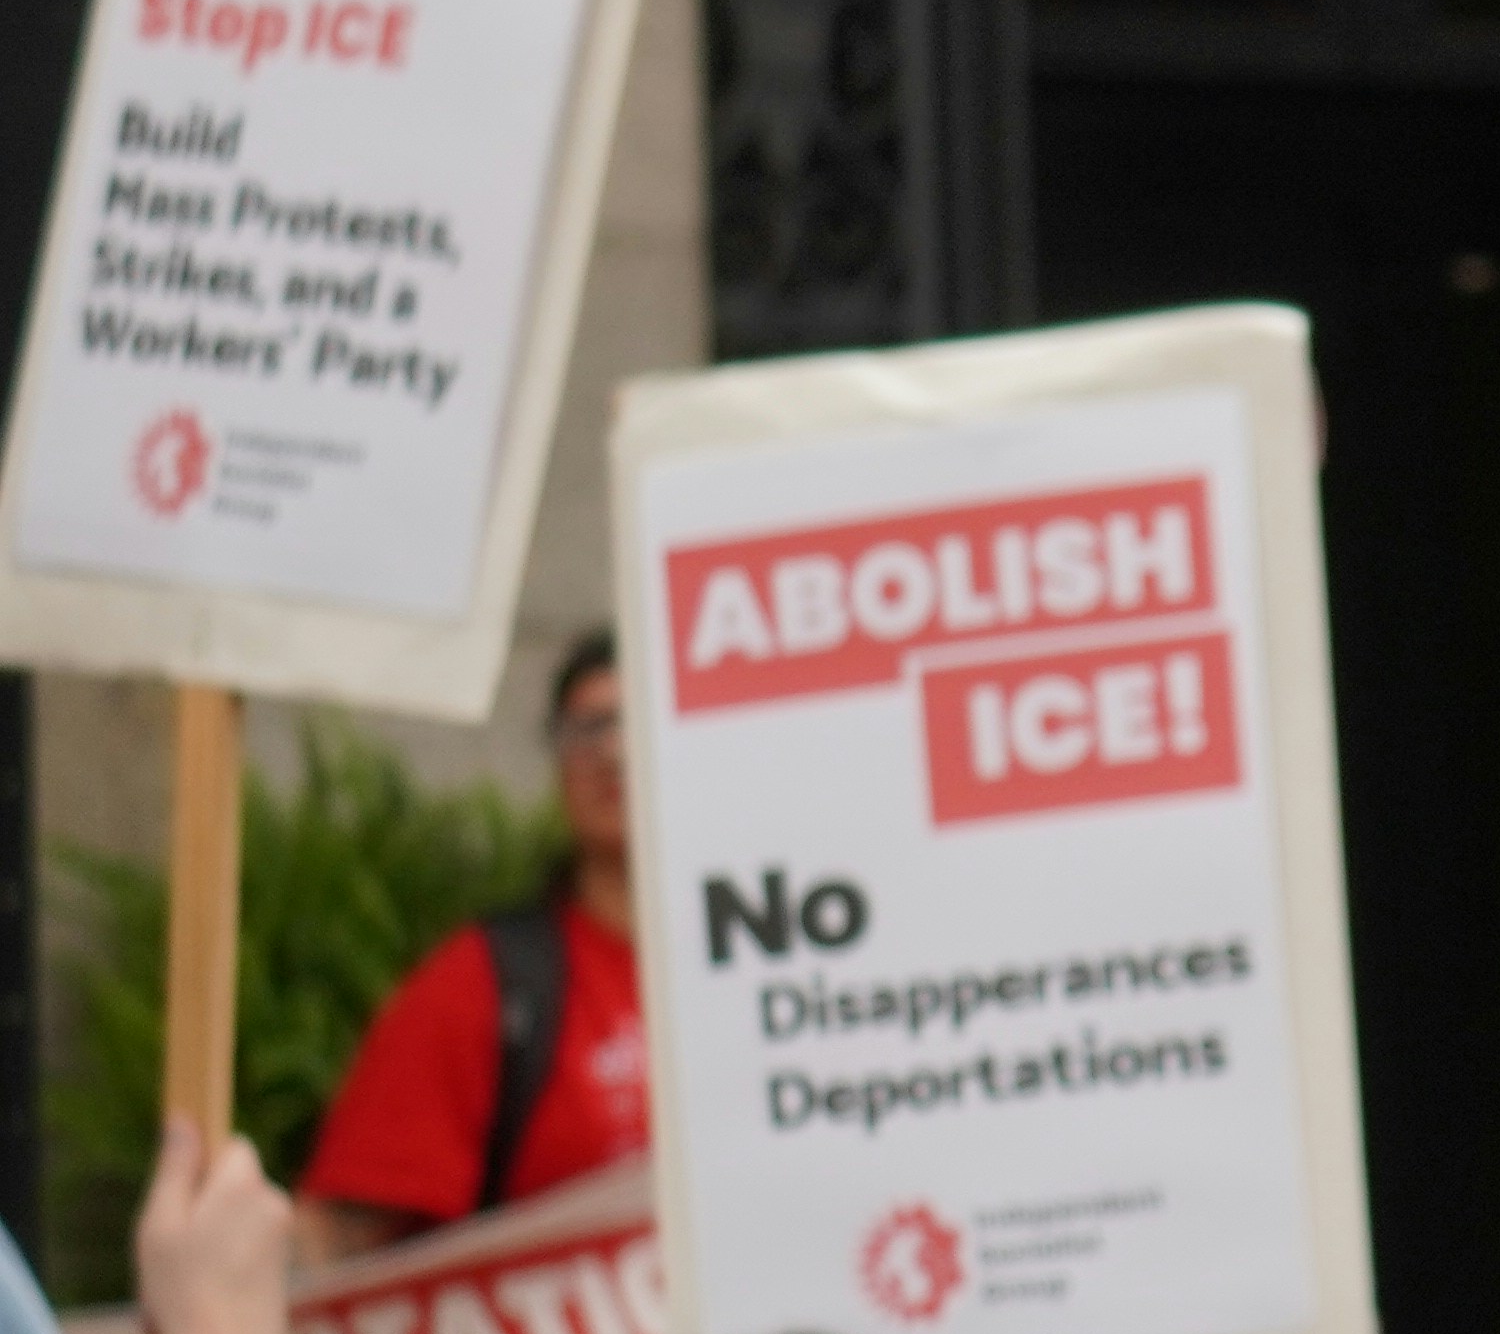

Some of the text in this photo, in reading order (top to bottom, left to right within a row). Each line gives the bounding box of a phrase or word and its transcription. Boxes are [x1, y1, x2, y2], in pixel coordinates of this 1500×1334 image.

[117, 100, 245, 161] Build
[104, 172, 461, 266] Mass Protests,
[283, 264, 380, 318] and
[391, 283, 417, 321] a
[312, 330, 458, 415] Party
[687, 504, 1194, 672] ABOLISH
[966, 654, 1209, 783] ICE!
[701, 866, 870, 967] No
[758, 933, 1254, 1043] Disapperances
[766, 1025, 1230, 1136] Deportations
